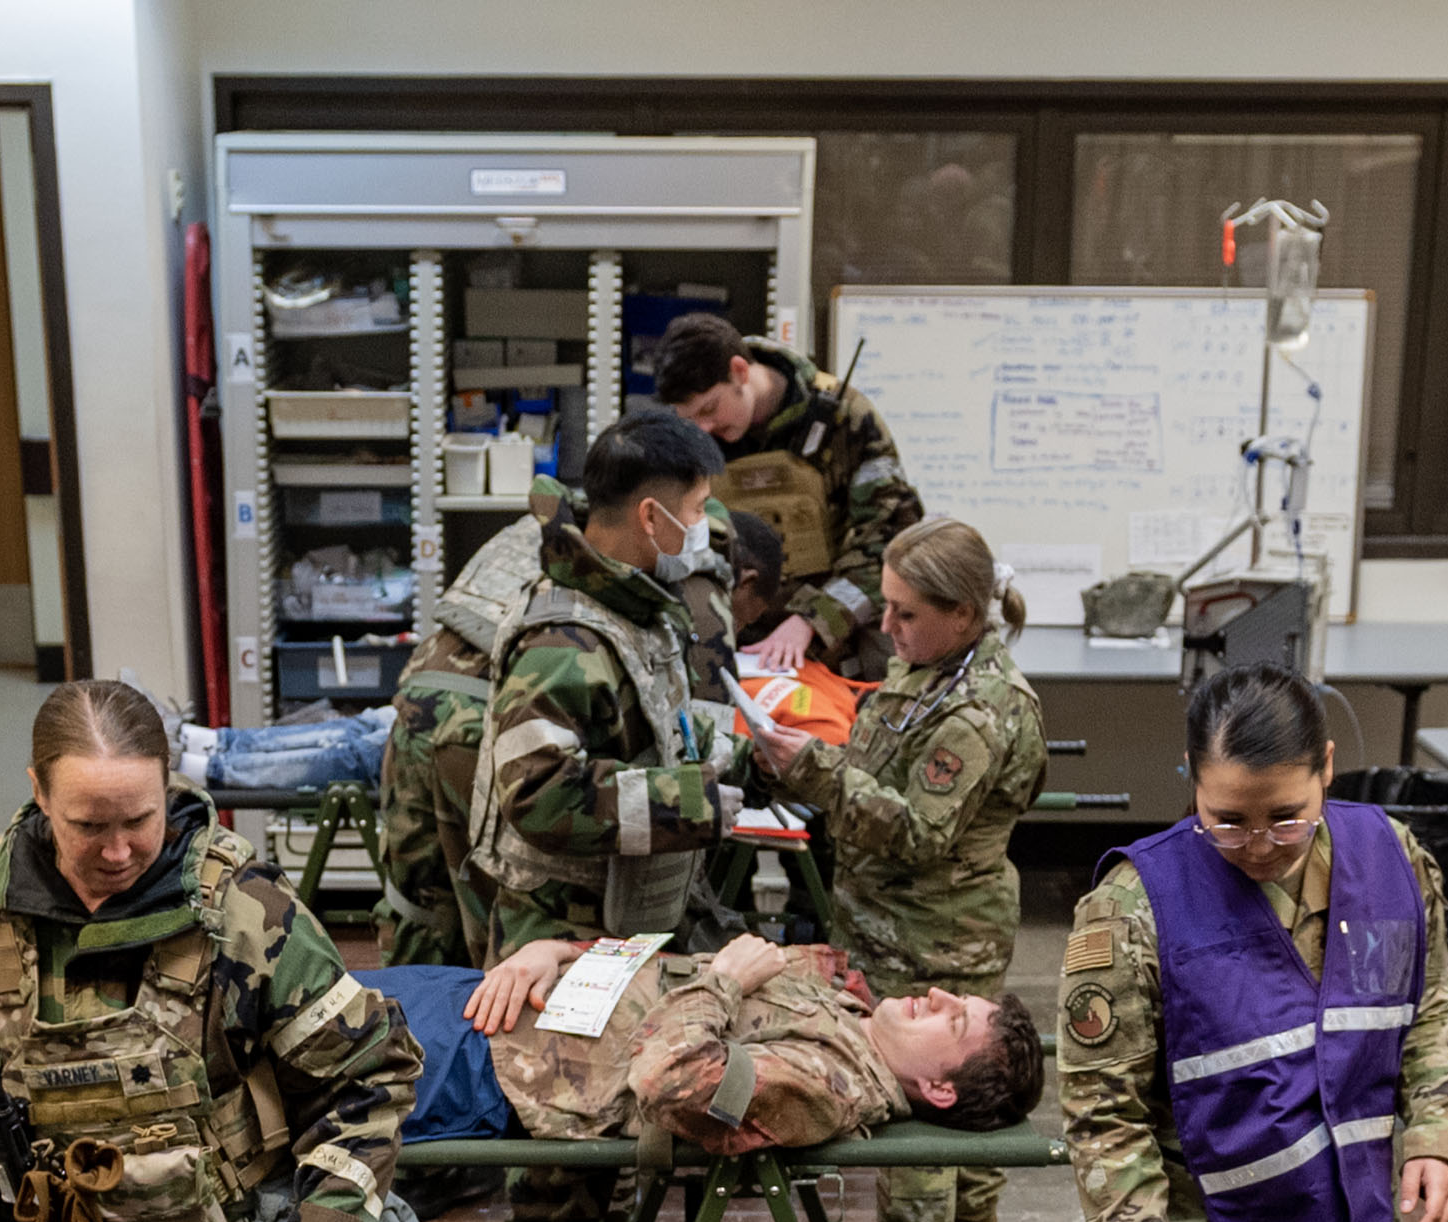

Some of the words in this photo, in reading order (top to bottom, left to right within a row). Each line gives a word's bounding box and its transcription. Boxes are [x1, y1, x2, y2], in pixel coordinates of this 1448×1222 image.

[781, 321, 794, 341] E
[234, 347, 249, 366] A
[238, 503, 253, 522] B
[420, 539, 437, 558] D
[241, 649, 255, 668] C
[42, 1063, 98, 1087] VARNEY
